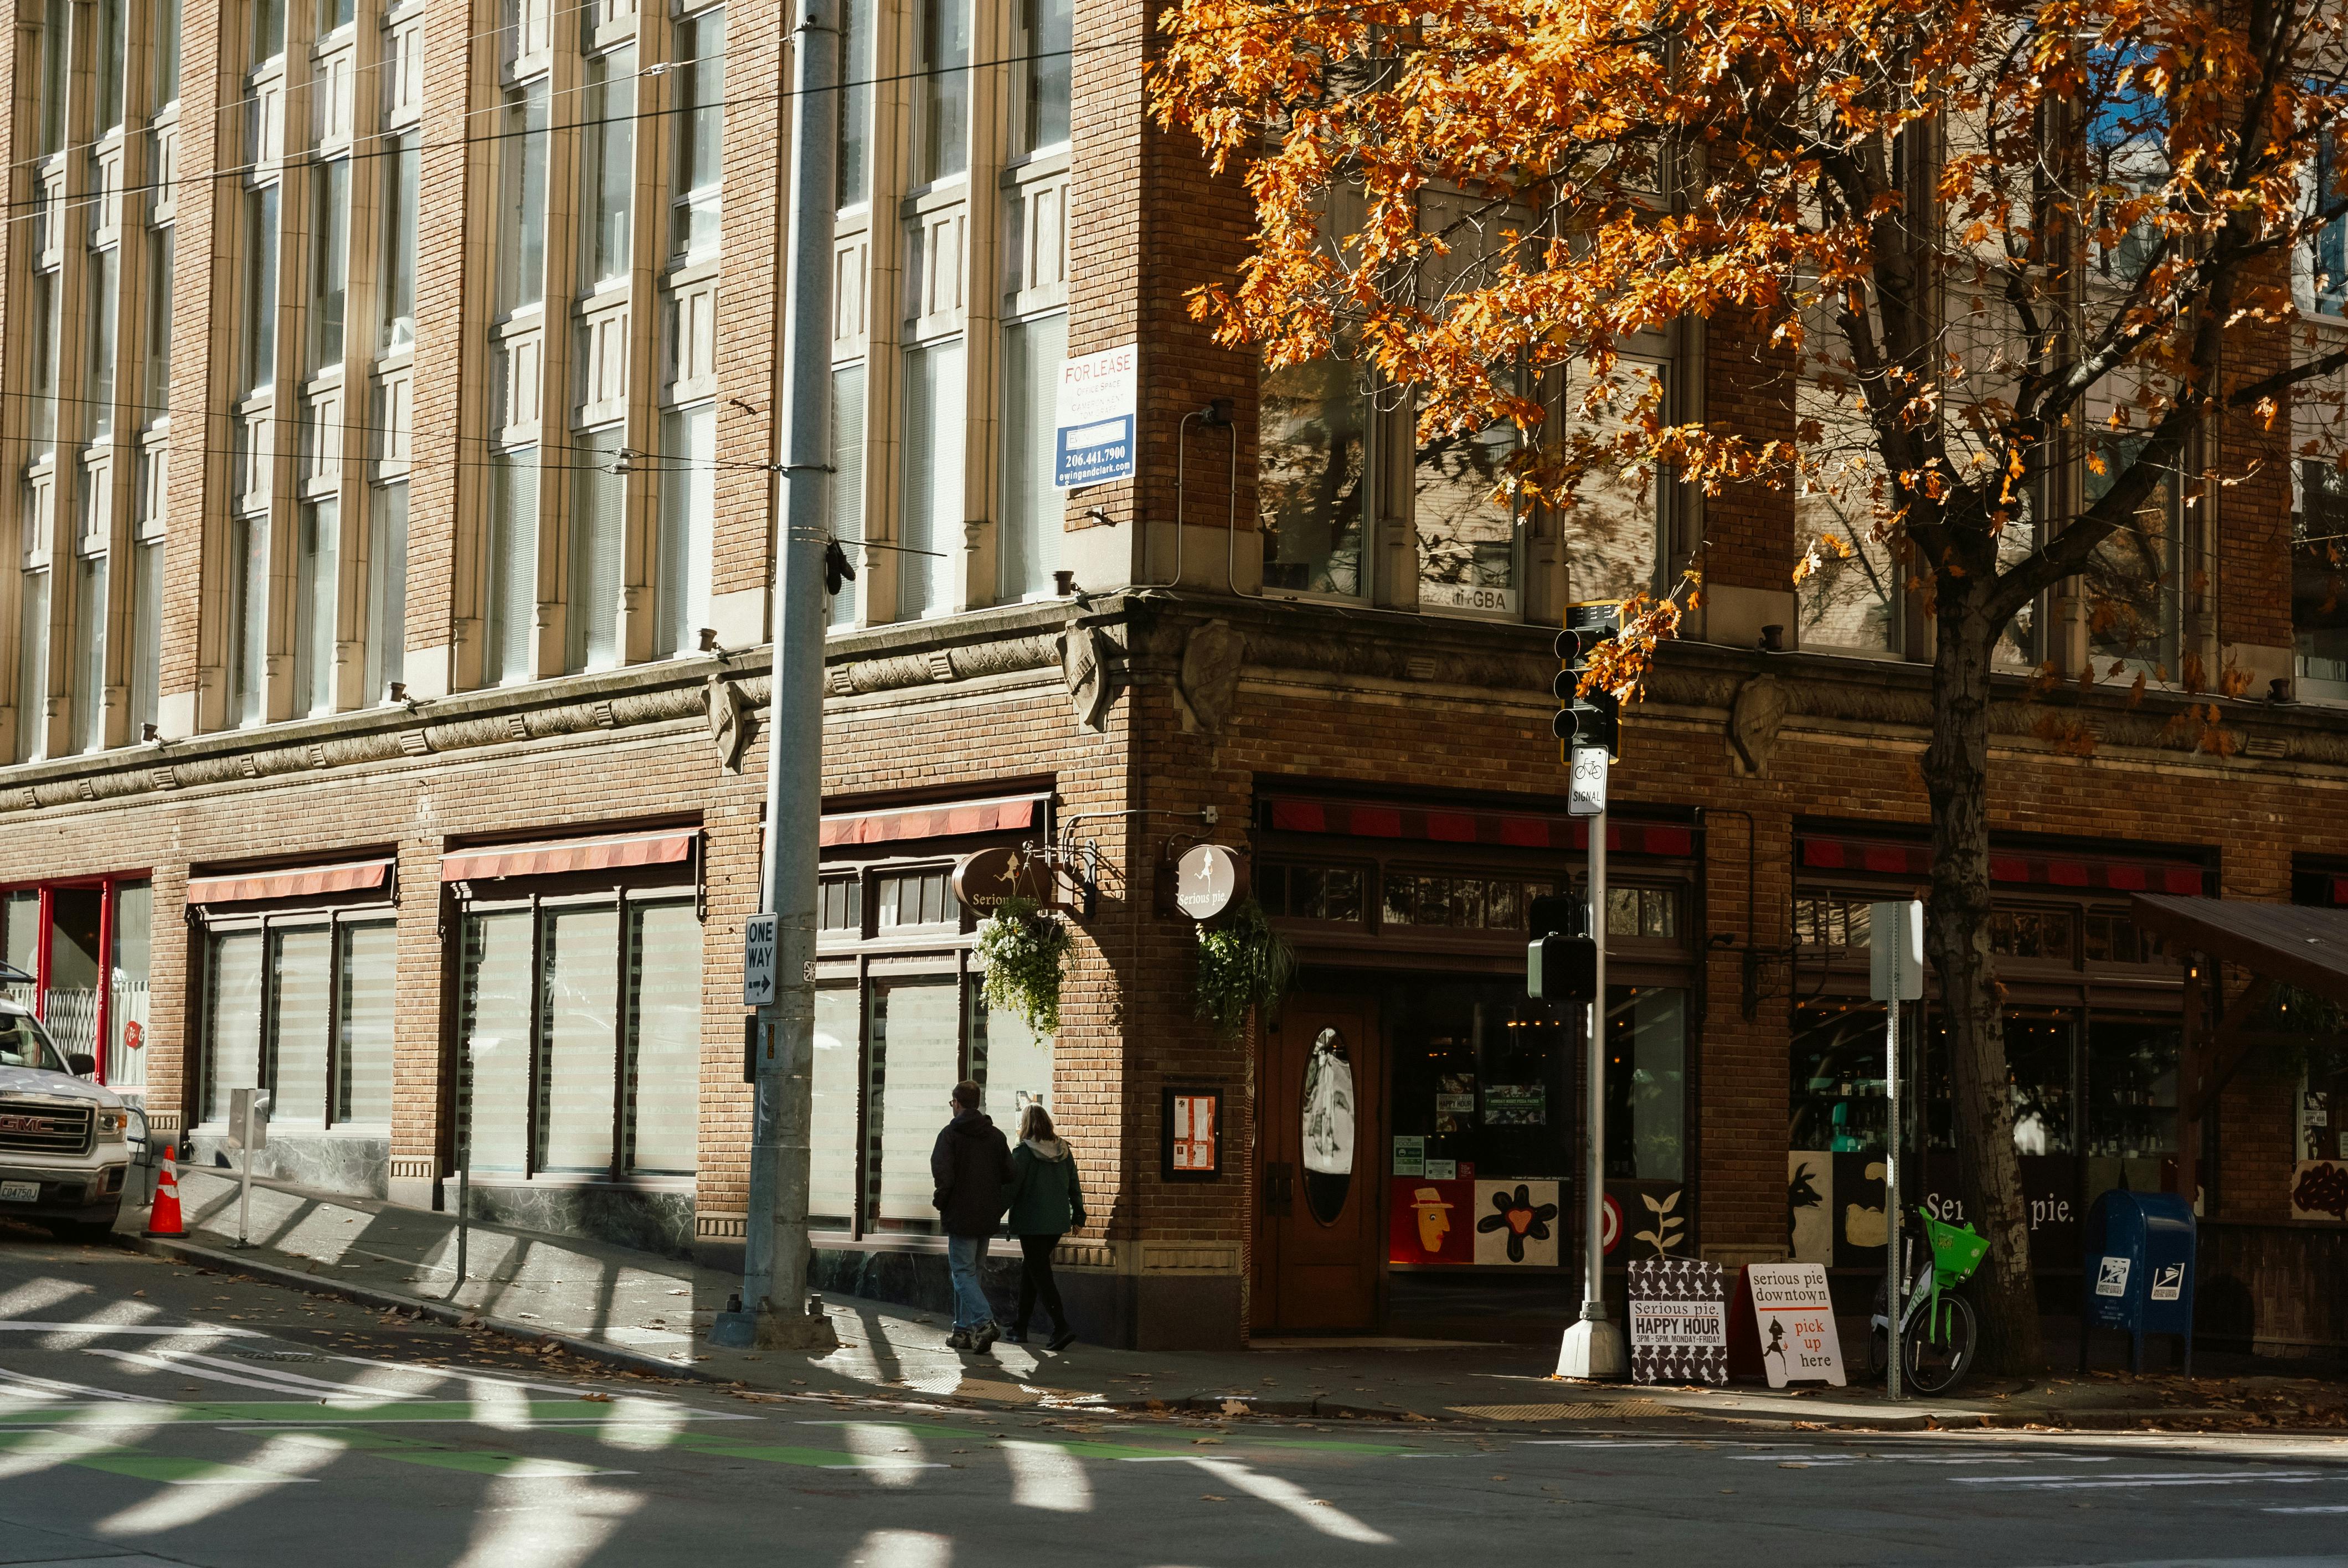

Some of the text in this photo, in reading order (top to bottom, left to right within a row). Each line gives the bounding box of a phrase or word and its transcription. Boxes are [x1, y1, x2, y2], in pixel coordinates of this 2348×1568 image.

[1065, 354, 1131, 384] FOR LEASE
[1100, 380, 1121, 391] SPACE
[1065, 445, 1125, 468] 206.441.7900
[1059, 461, 1130, 481] ewingandclark.com
[1573, 791, 1600, 802] SIGNAL
[973, 894, 1010, 905] Seriou
[1179, 890, 1227, 906] Serious pie.
[749, 922, 773, 943] ONE
[748, 947, 773, 968] WAY
[0, 1116, 54, 1133] GMC
[2031, 1193, 2073, 1230] pie.
[1753, 1270, 1824, 1288] serious pie
[1756, 1288, 1827, 1303] downtown
[1635, 1302, 1719, 1318] Serious pie.
[1636, 1318, 1719, 1335] HAPPY HOUR
[1795, 1318, 1825, 1337] pick
[1671, 1335, 1720, 1343] MONDAY-FRIDAY
[1804, 1338, 1821, 1352] up
[1800, 1353, 1831, 1367] here
